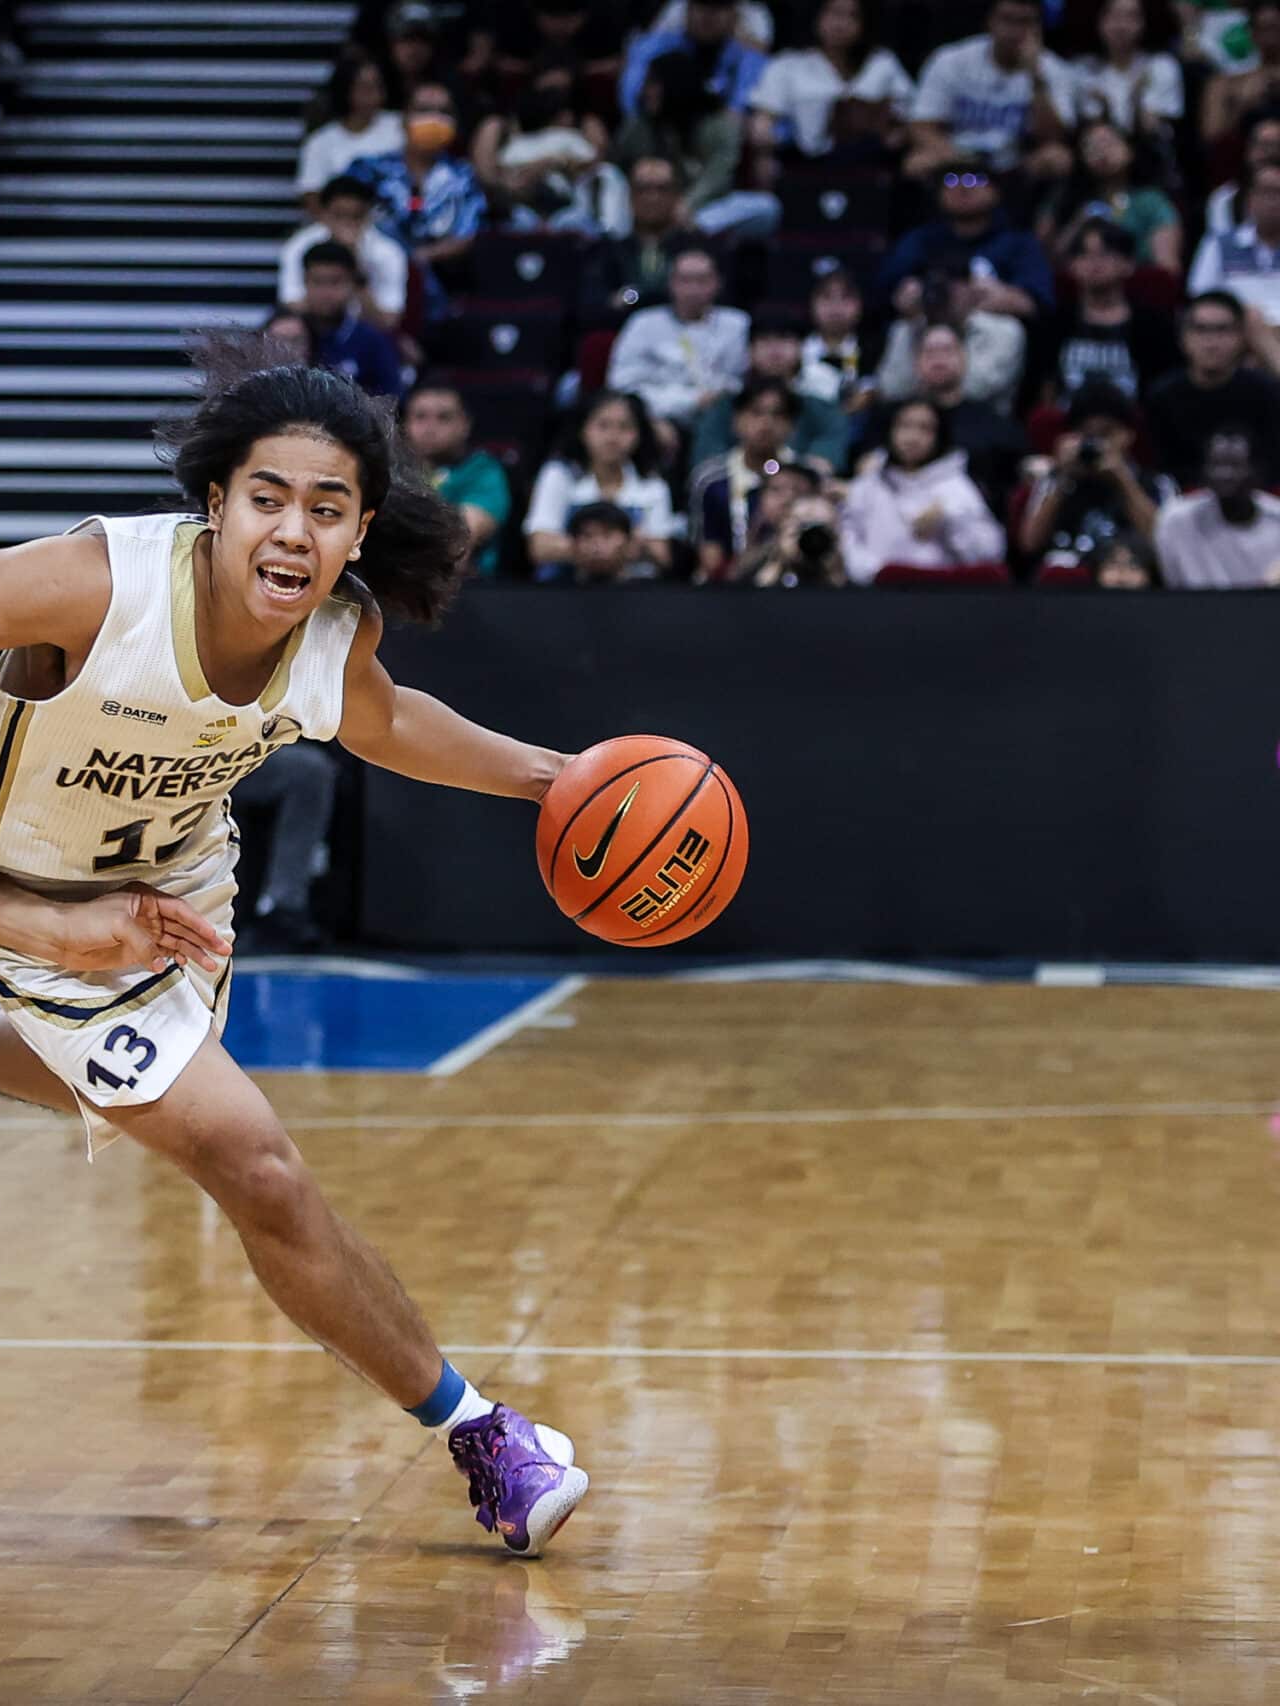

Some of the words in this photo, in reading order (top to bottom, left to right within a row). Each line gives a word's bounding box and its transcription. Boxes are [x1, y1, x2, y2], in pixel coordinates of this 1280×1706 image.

[123, 707, 168, 723] DATEM
[55, 759, 262, 799] UNIVERSIT
[618, 827, 710, 922] ELITE
[86, 1024, 157, 1089] 13
